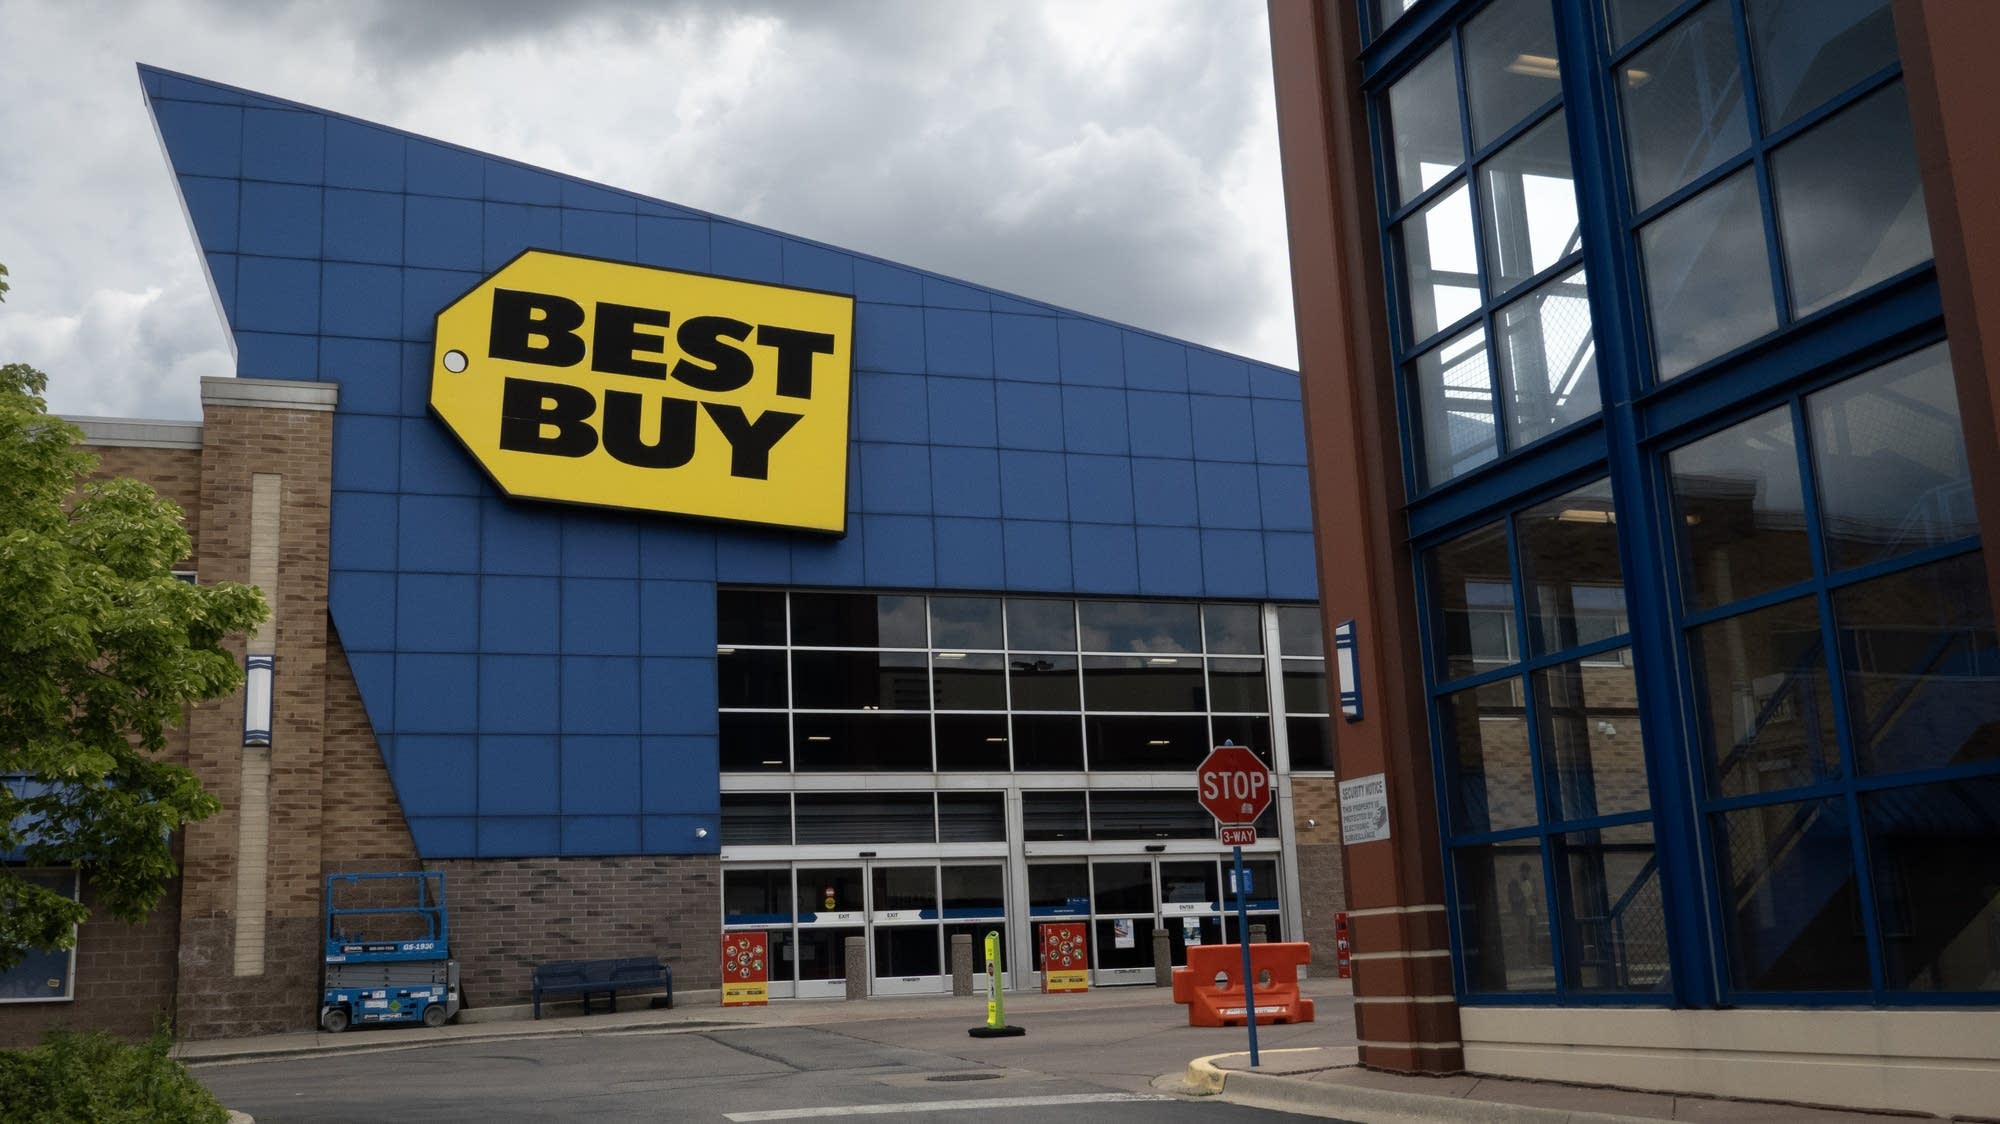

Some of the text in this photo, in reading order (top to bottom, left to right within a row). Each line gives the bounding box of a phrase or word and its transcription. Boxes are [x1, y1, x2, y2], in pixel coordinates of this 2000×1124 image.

[488, 287, 835, 400] BEST
[500, 377, 805, 481] BUY
[1203, 771, 1265, 800] STOP
[1342, 781, 1382, 800] SECURITY NOTICE
[1343, 805, 1352, 813] THIS
[1353, 802, 1374, 811] PROPERTY
[1344, 813, 1367, 823] PROTECTED
[1344, 822, 1369, 832] ELECTRONIC
[1223, 830, 1253, 843] 3-WAY
[1345, 831, 1375, 841] SURVEILLANCE
